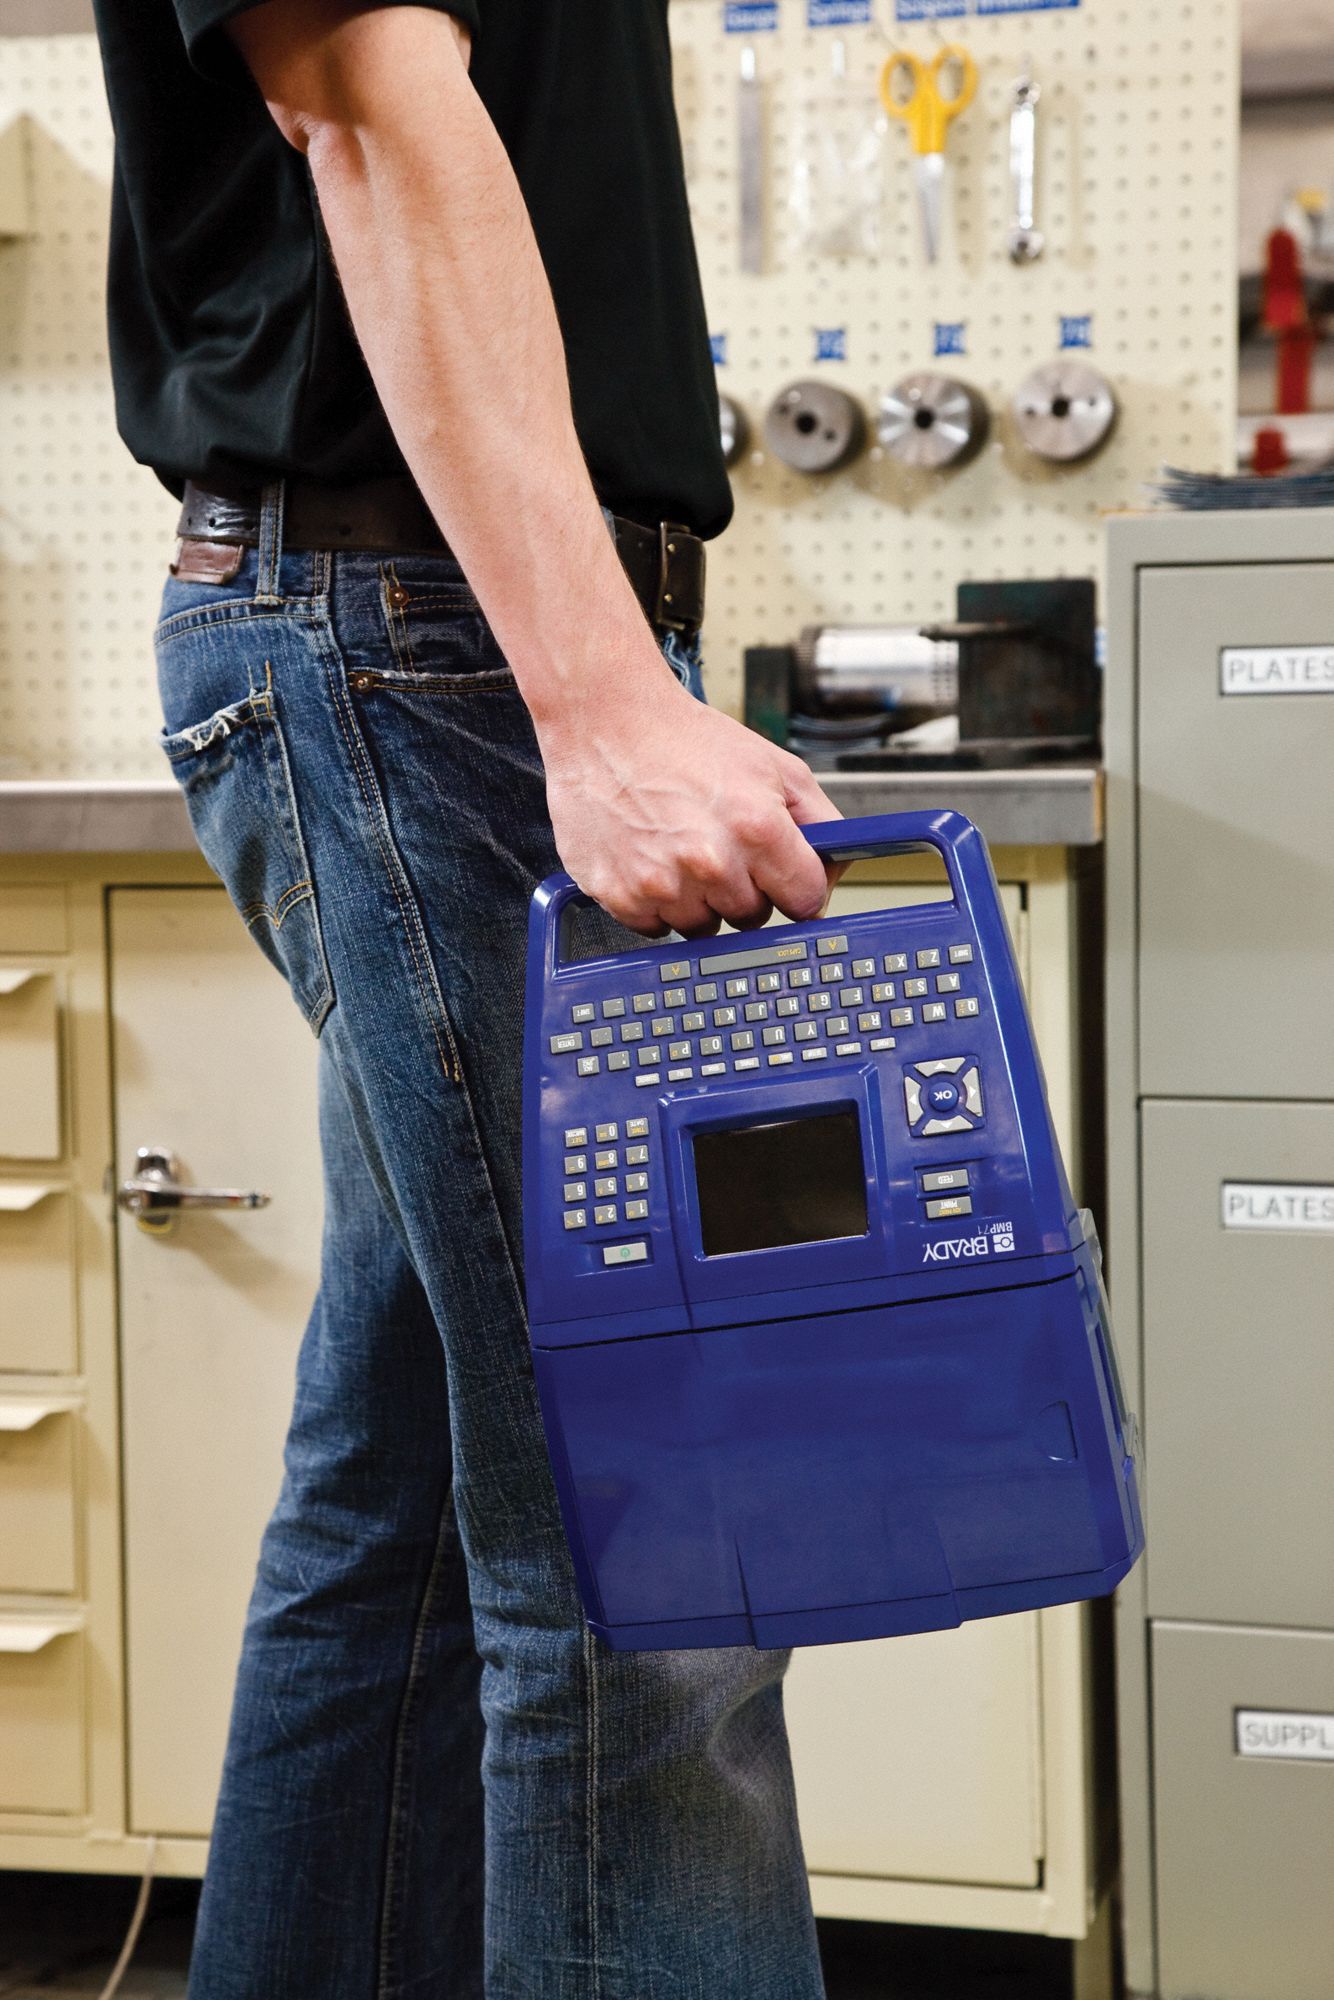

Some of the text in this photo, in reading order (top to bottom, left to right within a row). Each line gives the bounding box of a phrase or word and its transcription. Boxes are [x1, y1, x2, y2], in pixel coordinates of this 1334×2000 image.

[1228, 655, 1334, 682] PLATES
[558, 1039, 575, 1048] ENTER
[934, 1090, 952, 1100] OK
[938, 1175, 954, 1184] FEED
[1228, 1193, 1334, 1220] PLATES
[978, 1222, 1012, 1235] BMP71
[924, 1236, 988, 1262] BRADY
